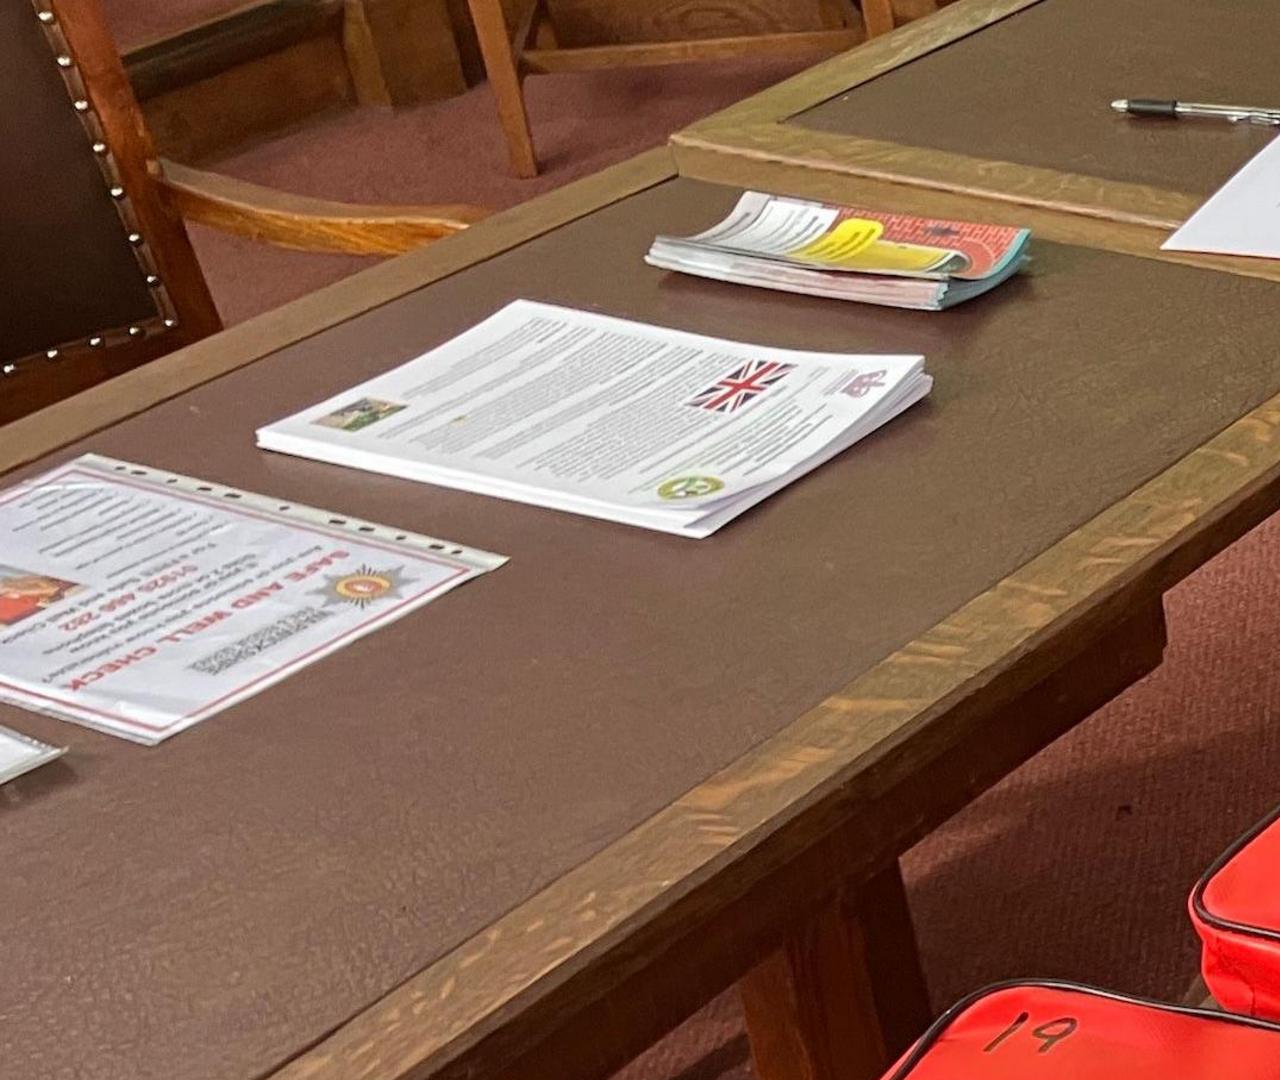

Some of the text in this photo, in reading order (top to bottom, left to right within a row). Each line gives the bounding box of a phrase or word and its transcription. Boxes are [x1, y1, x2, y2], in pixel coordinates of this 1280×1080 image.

[283, 549, 350, 582] SAFE
[230, 581, 285, 609] AND
[156, 610, 233, 643] WELL
[64, 645, 157, 692] CHECK
[983, 1011, 1078, 1053] 19
